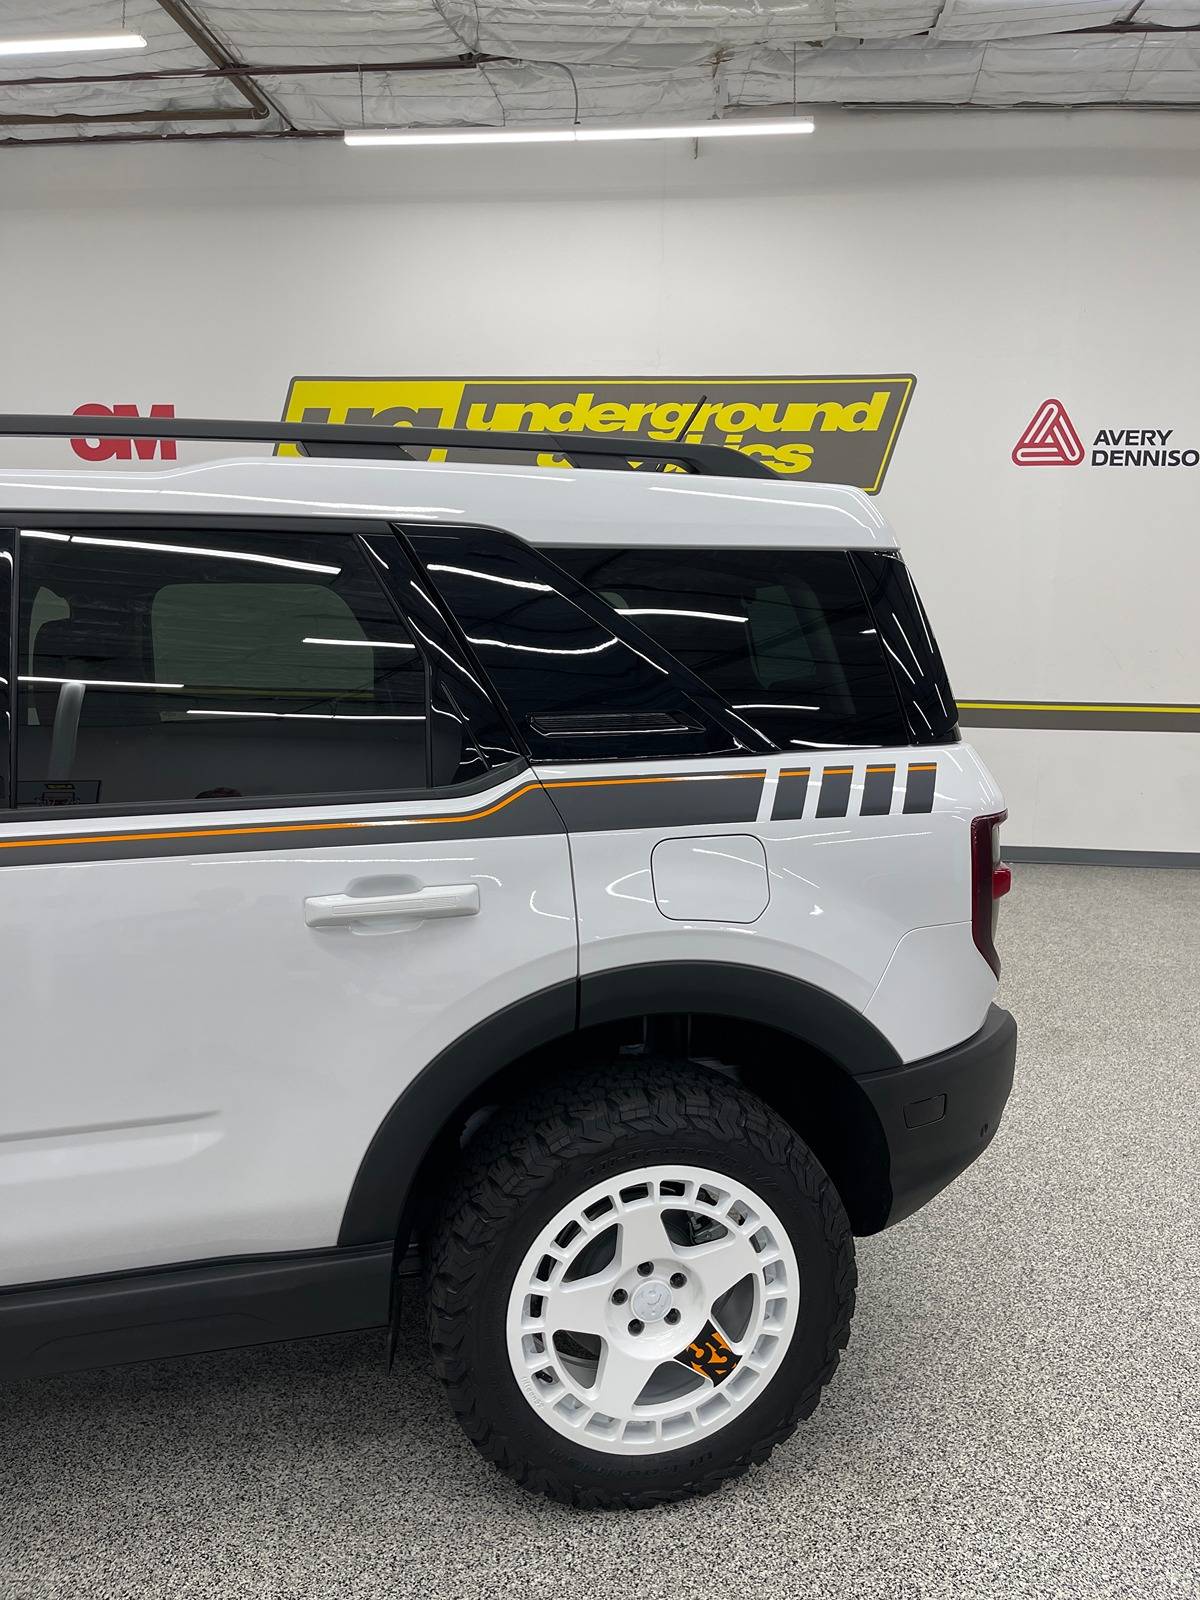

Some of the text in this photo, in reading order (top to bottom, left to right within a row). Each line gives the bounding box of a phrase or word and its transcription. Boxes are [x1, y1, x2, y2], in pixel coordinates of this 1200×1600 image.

[465, 391, 891, 441] underground
[1093, 429, 1174, 446] AVERY
[1091, 449, 1200, 467] DENNISO
